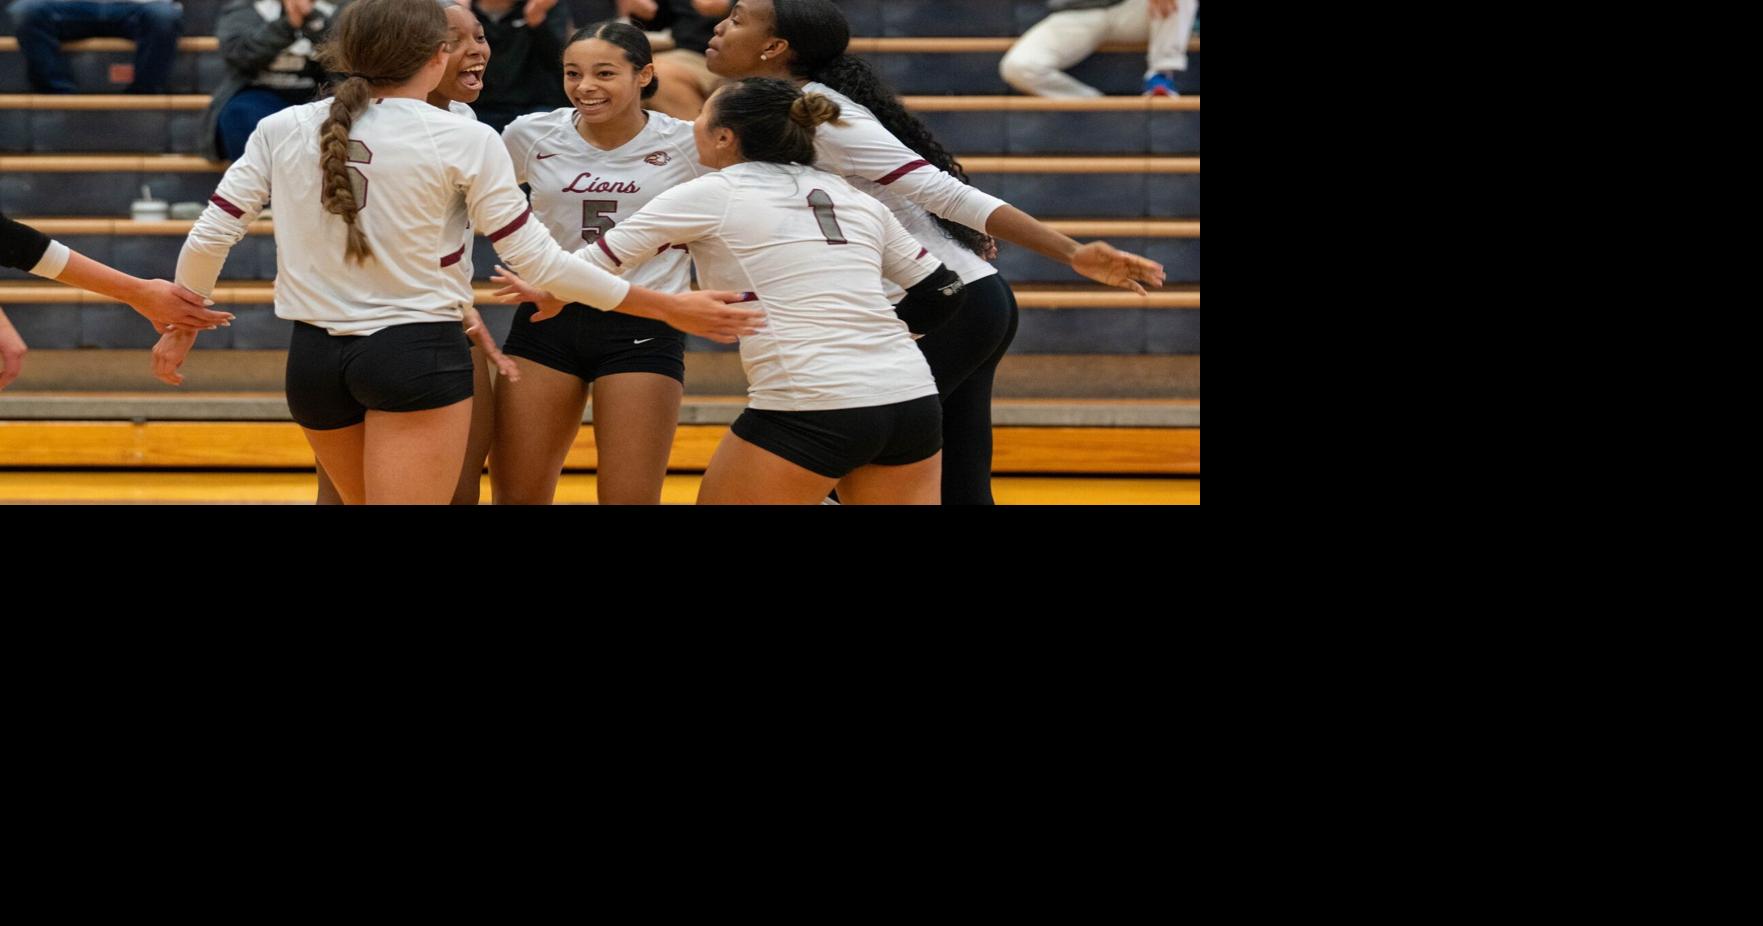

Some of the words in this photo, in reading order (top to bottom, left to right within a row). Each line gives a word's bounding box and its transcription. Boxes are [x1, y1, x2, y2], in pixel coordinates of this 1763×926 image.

[562, 172, 641, 193] Lions
[582, 199, 618, 244] 5
[806, 188, 848, 245] 1
